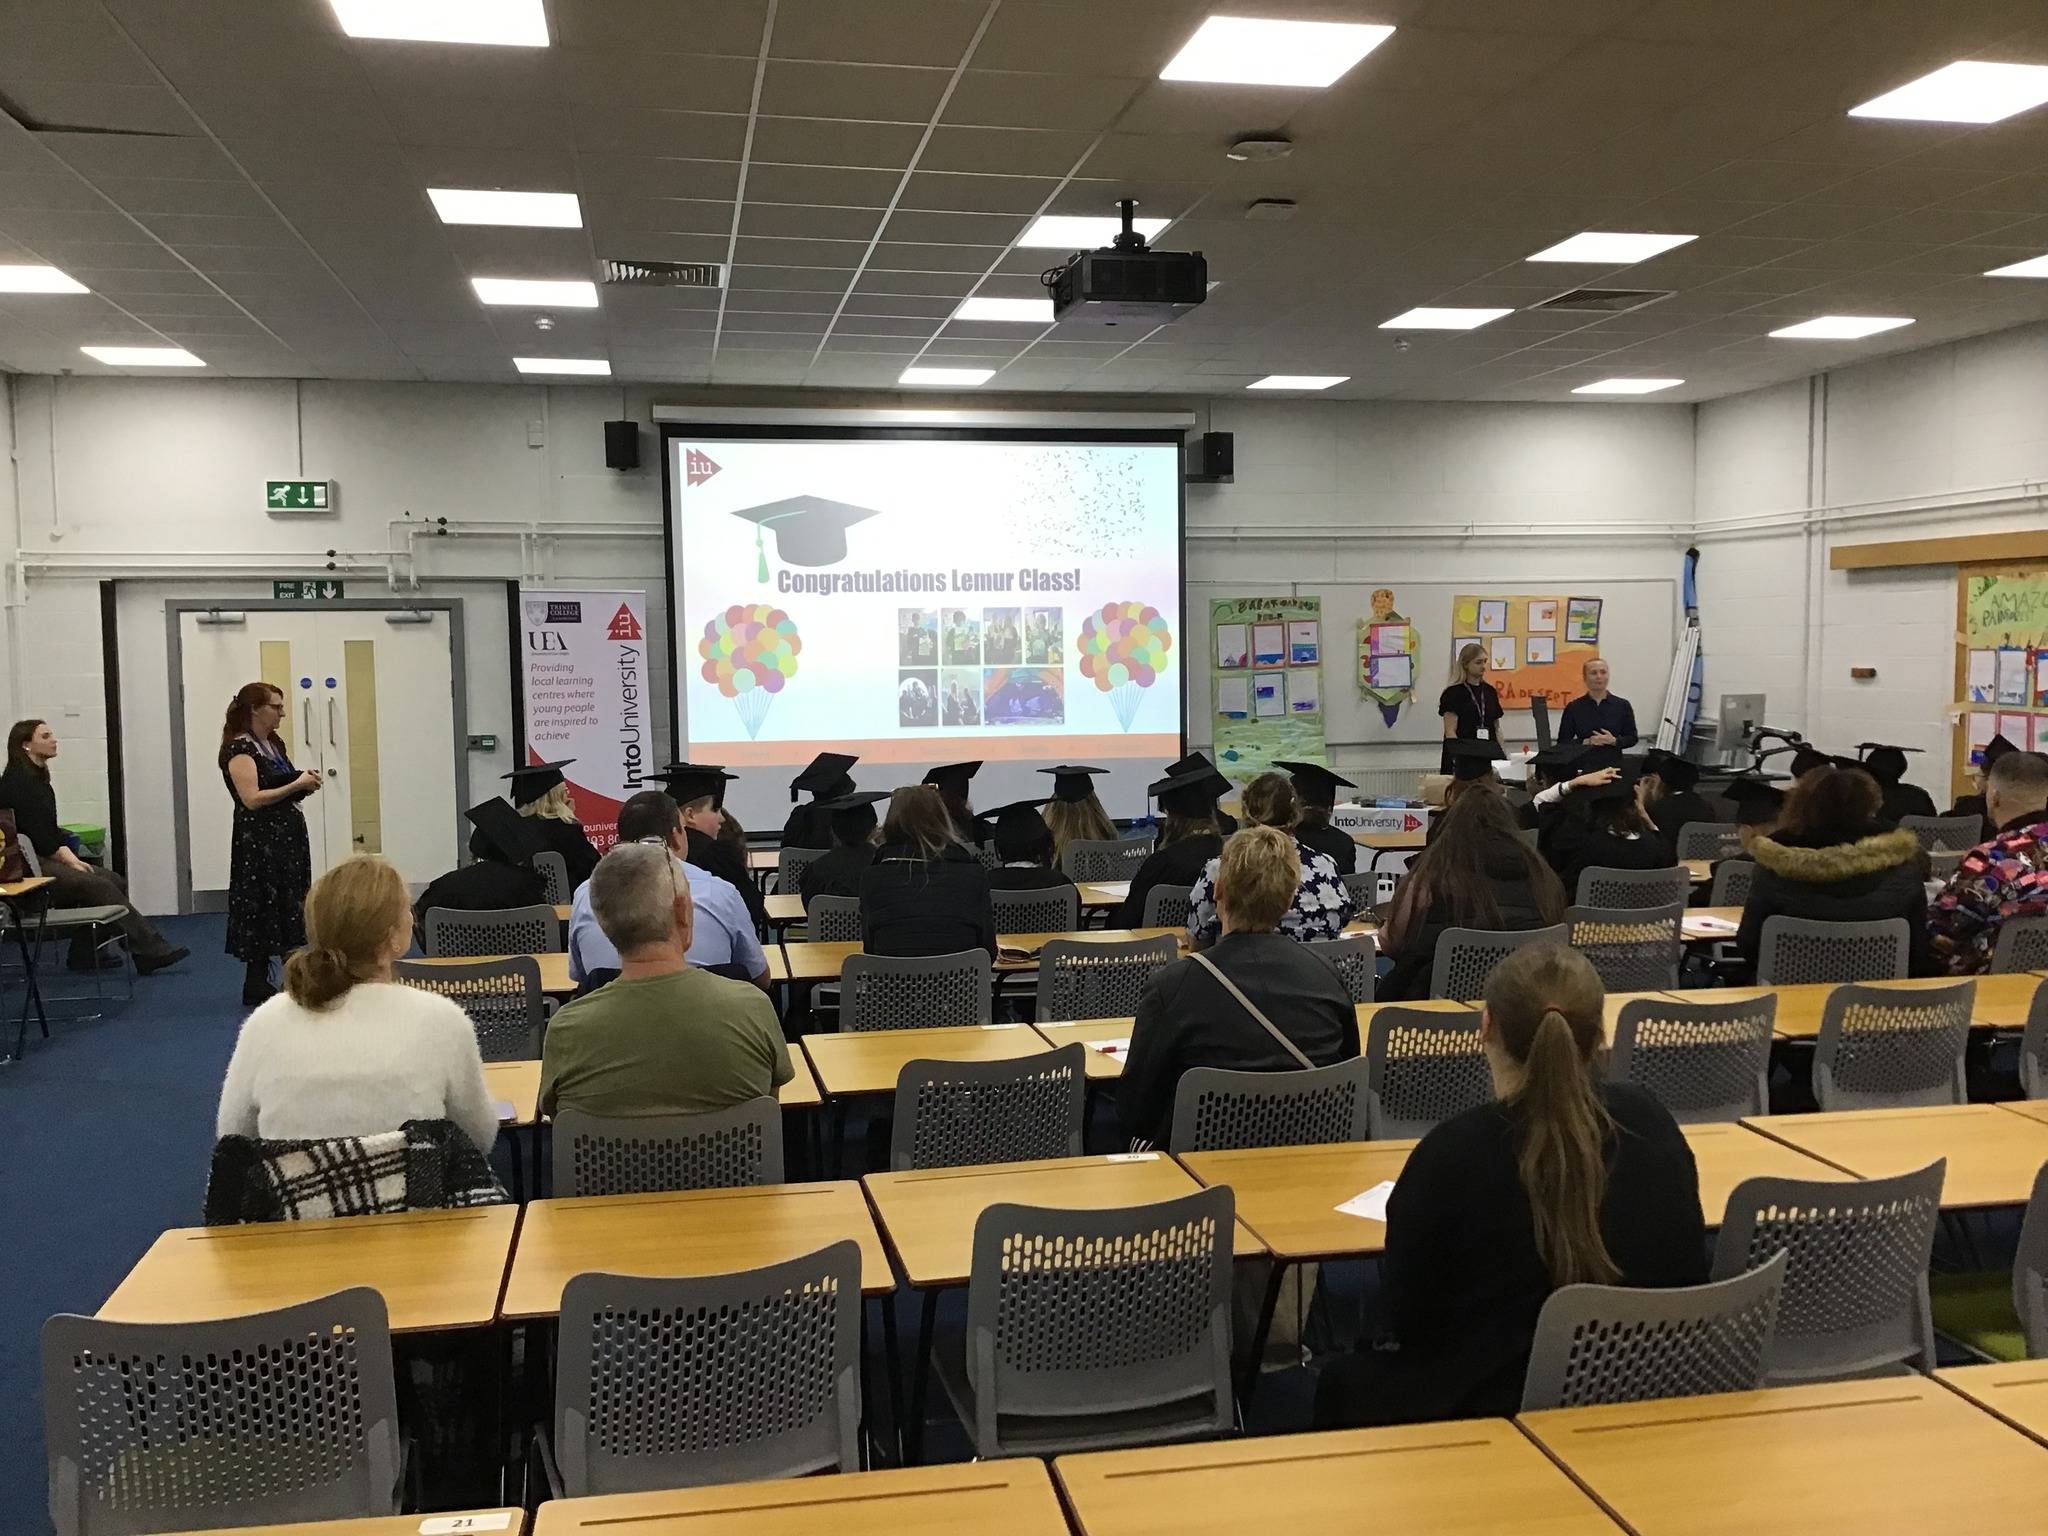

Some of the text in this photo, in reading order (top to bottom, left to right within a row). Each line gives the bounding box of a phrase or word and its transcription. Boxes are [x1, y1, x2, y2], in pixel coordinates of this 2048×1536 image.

[690, 456, 713, 475] iu
[777, 568, 1081, 597] Congratulations Lemur Class!
[528, 631, 569, 650] UEA
[530, 663, 574, 674] Providing
[531, 675, 594, 688] local learning
[532, 689, 596, 700] centres where
[532, 702, 596, 716] young people
[534, 716, 599, 727] are inspired to
[617, 644, 643, 789] IntoUniversity
[534, 731, 570, 741] achieve
[1334, 815, 1403, 831] IntoUniversity
[451, 1518, 473, 1528] 21
